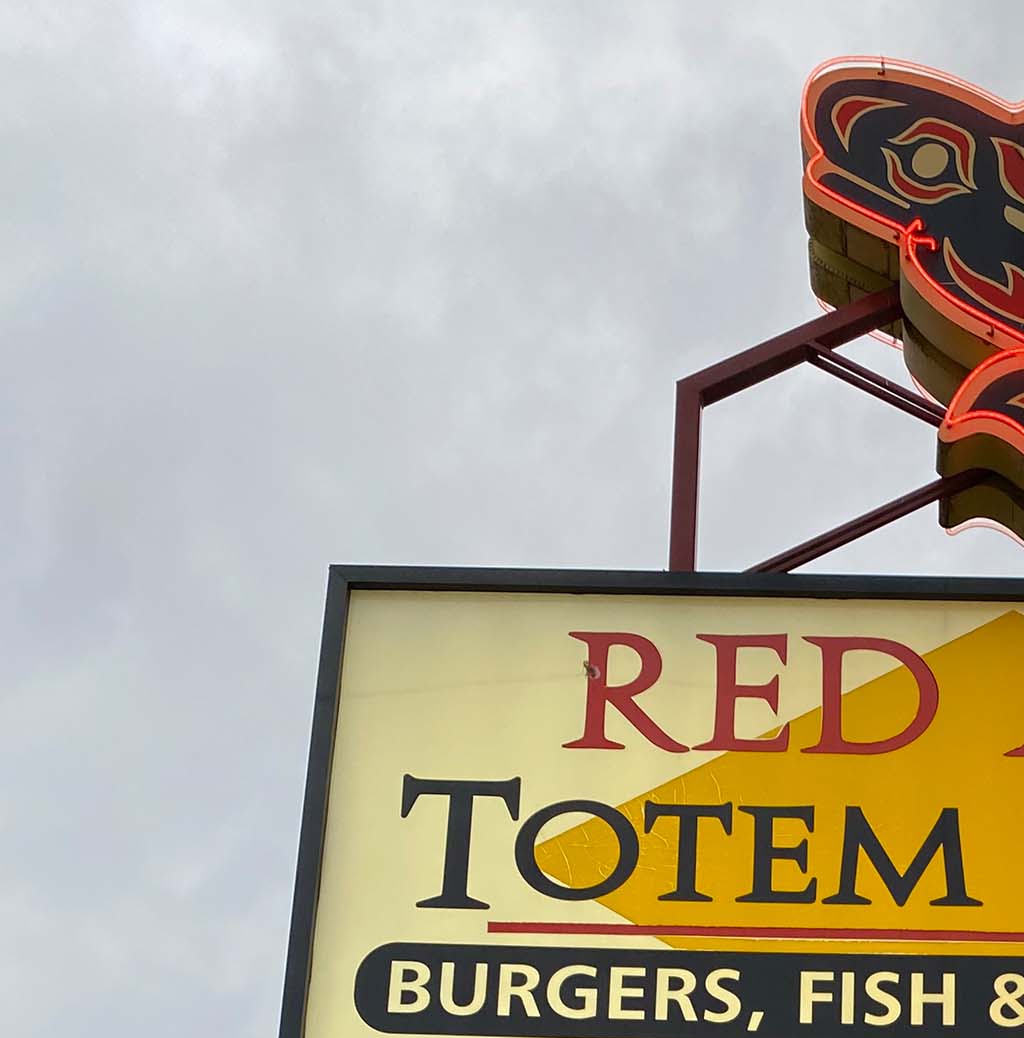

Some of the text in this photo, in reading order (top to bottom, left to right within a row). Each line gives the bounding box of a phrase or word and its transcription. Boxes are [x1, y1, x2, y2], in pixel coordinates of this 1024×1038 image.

[562, 631, 940, 756] RED
[400, 773, 983, 910] TOTEM
[386, 960, 765, 1033] BURGERS,
[799, 970, 956, 1026] FISH
